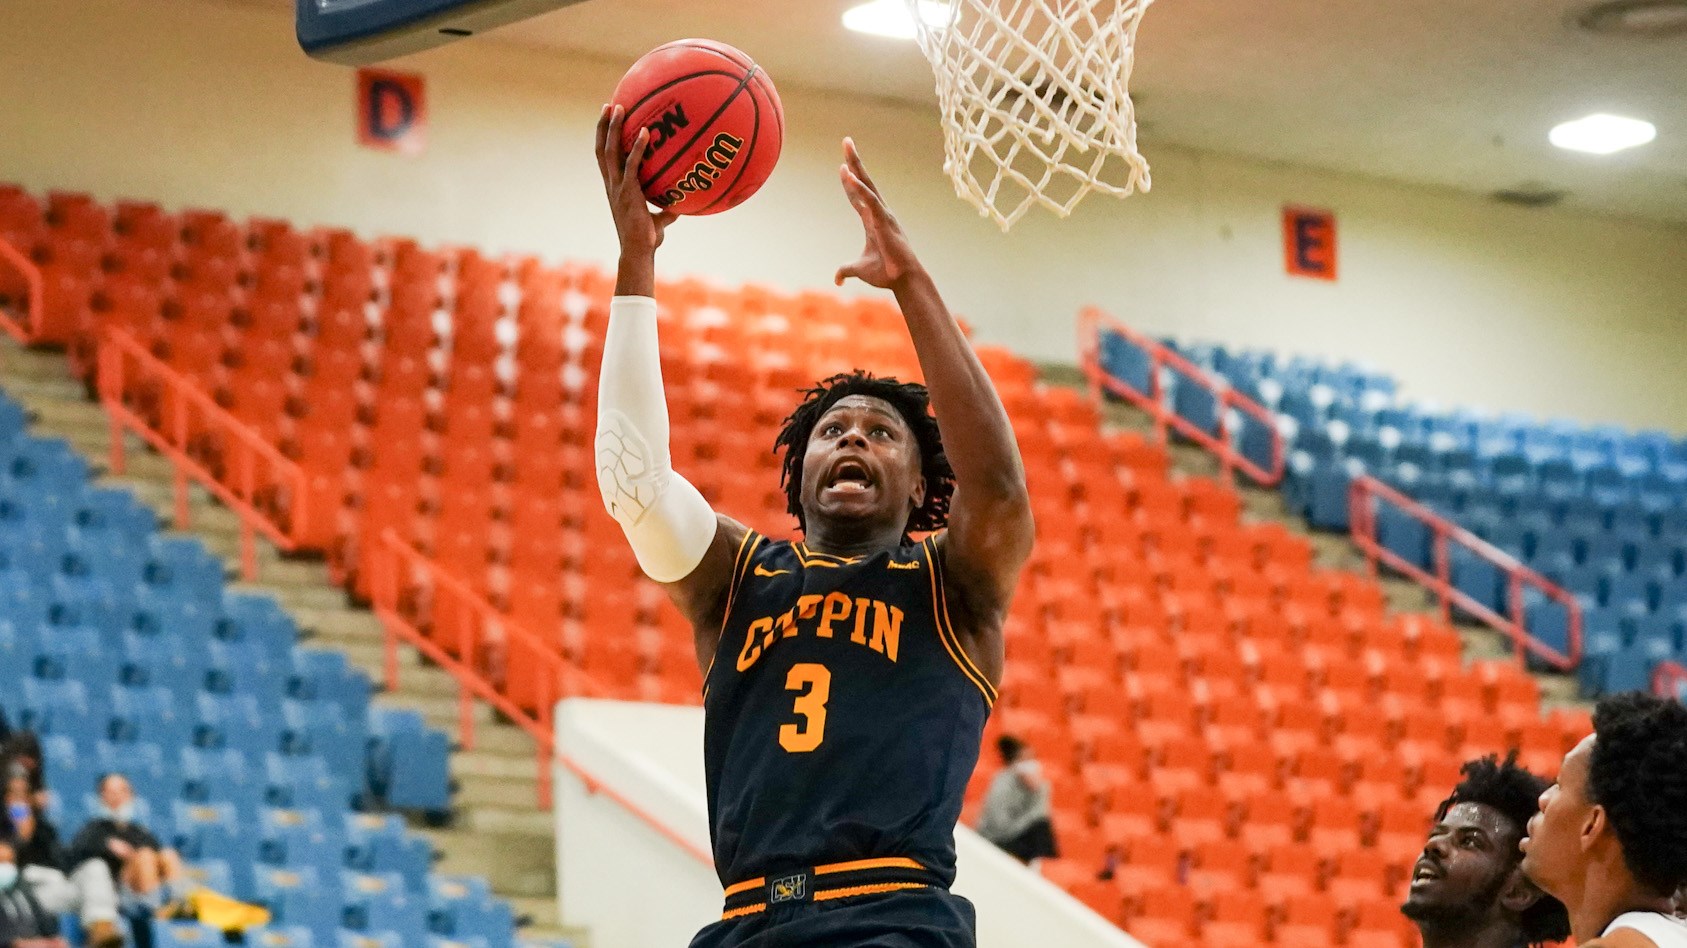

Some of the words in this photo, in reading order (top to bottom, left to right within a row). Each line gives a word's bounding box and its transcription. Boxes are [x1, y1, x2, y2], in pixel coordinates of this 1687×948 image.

[369, 79, 416, 139] D
[640, 103, 689, 166] NC
[1295, 216, 1325, 272] E
[778, 663, 831, 753] 3
